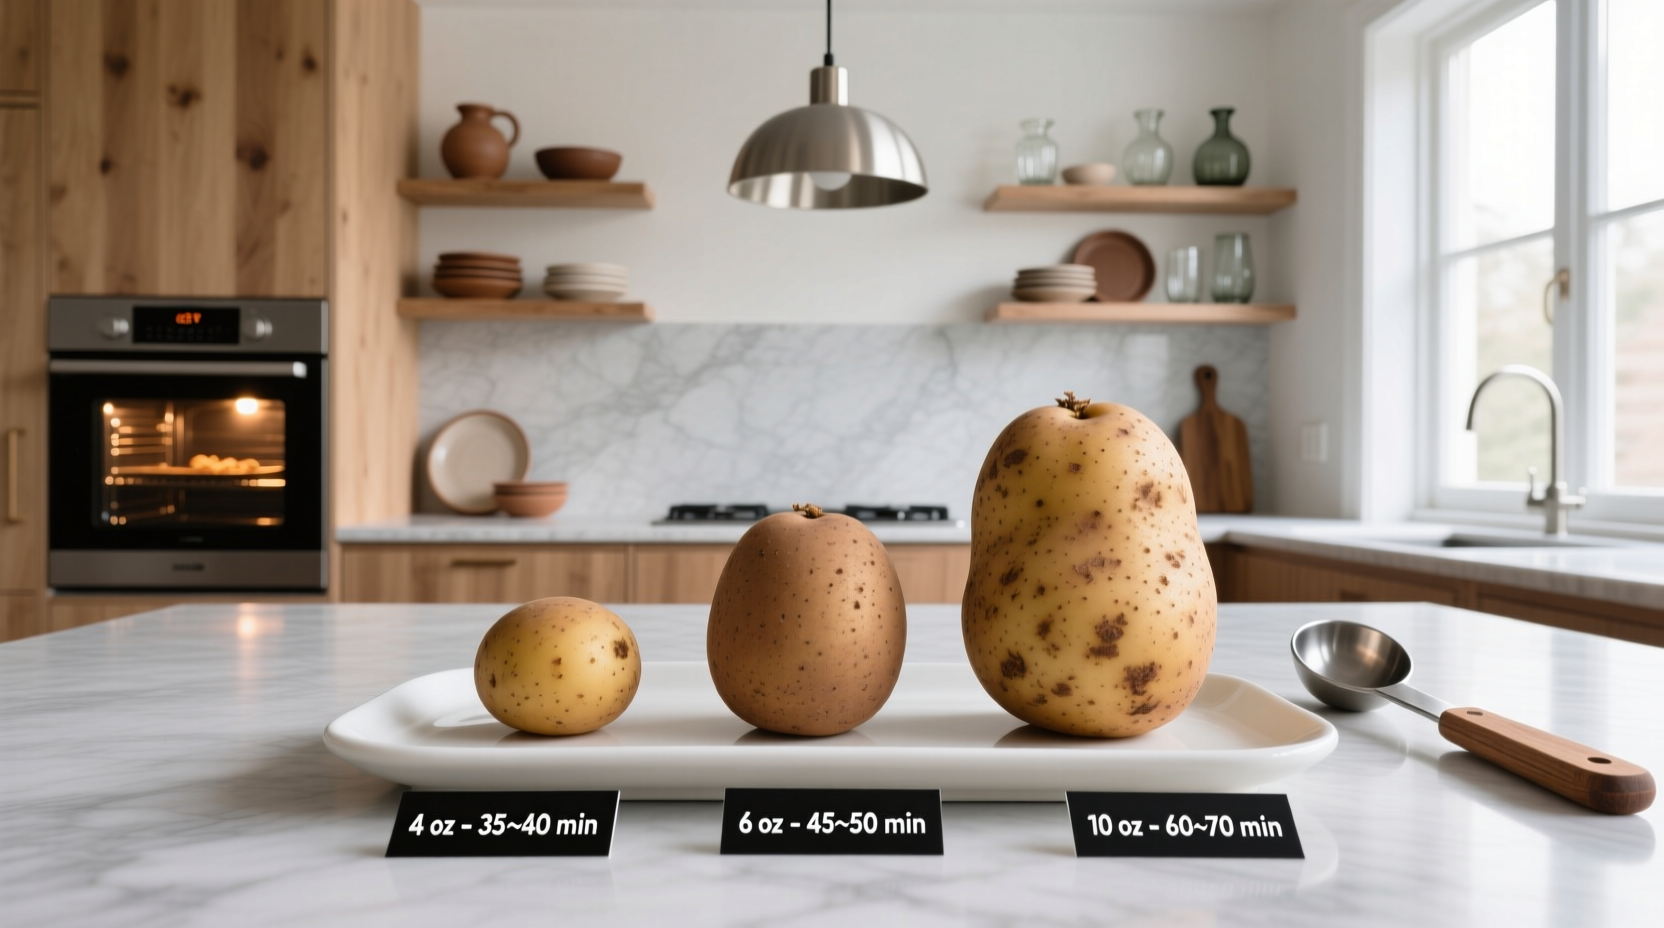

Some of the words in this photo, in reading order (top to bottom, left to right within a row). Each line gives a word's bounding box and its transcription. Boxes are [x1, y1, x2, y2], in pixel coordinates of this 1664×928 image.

[408, 813, 425, 836] 4
[429, 819, 456, 836] oz
[477, 812, 551, 836] 35~40
[556, 812, 598, 835] min
[738, 811, 753, 834] 6
[758, 817, 784, 834] oz
[806, 811, 878, 834] 45~50
[884, 811, 926, 834] min
[1087, 813, 1113, 836] 10
[1118, 819, 1144, 837] oz
[1165, 814, 1235, 837] 60~70
[1239, 814, 1283, 837] min
